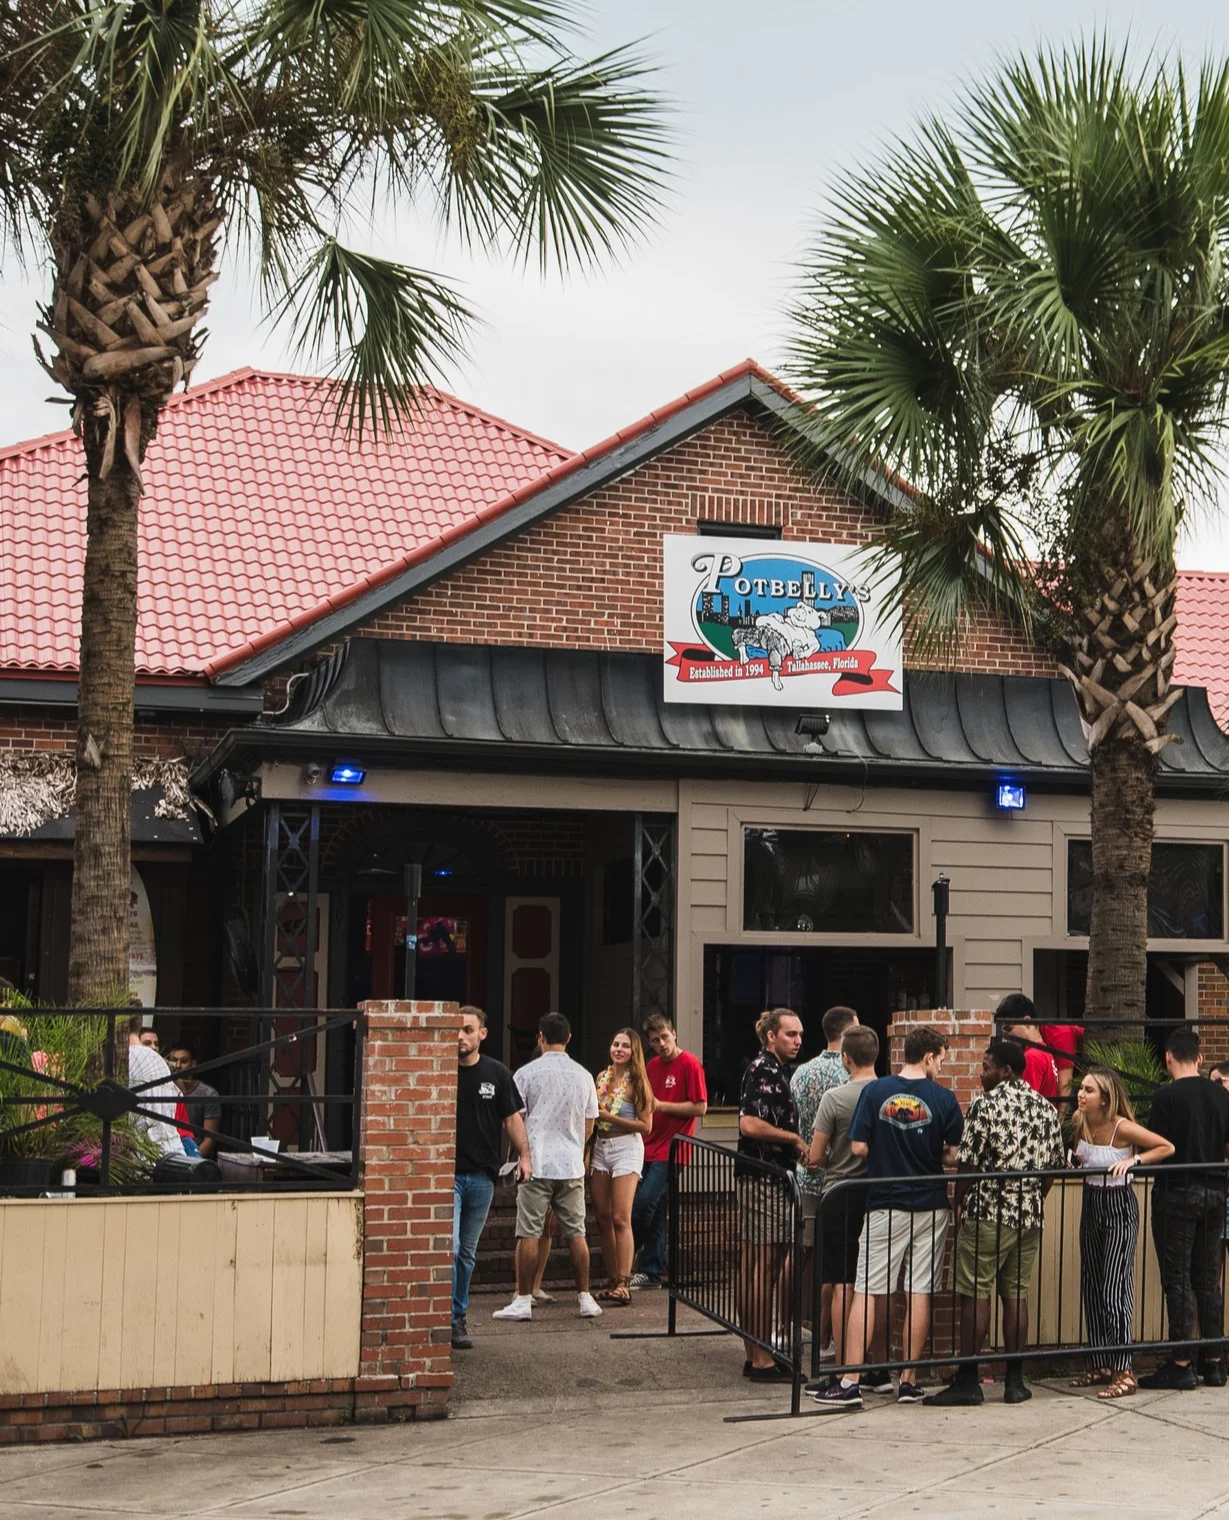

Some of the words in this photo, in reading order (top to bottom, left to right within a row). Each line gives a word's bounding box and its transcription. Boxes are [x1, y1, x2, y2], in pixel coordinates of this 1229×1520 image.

[690, 551, 871, 602] POTBELLY'S
[689, 665, 733, 679] Established
[735, 665, 743, 677] in
[745, 663, 764, 677] 1994
[787, 660, 831, 673] Tallahassee,
[832, 656, 859, 669] Florida
